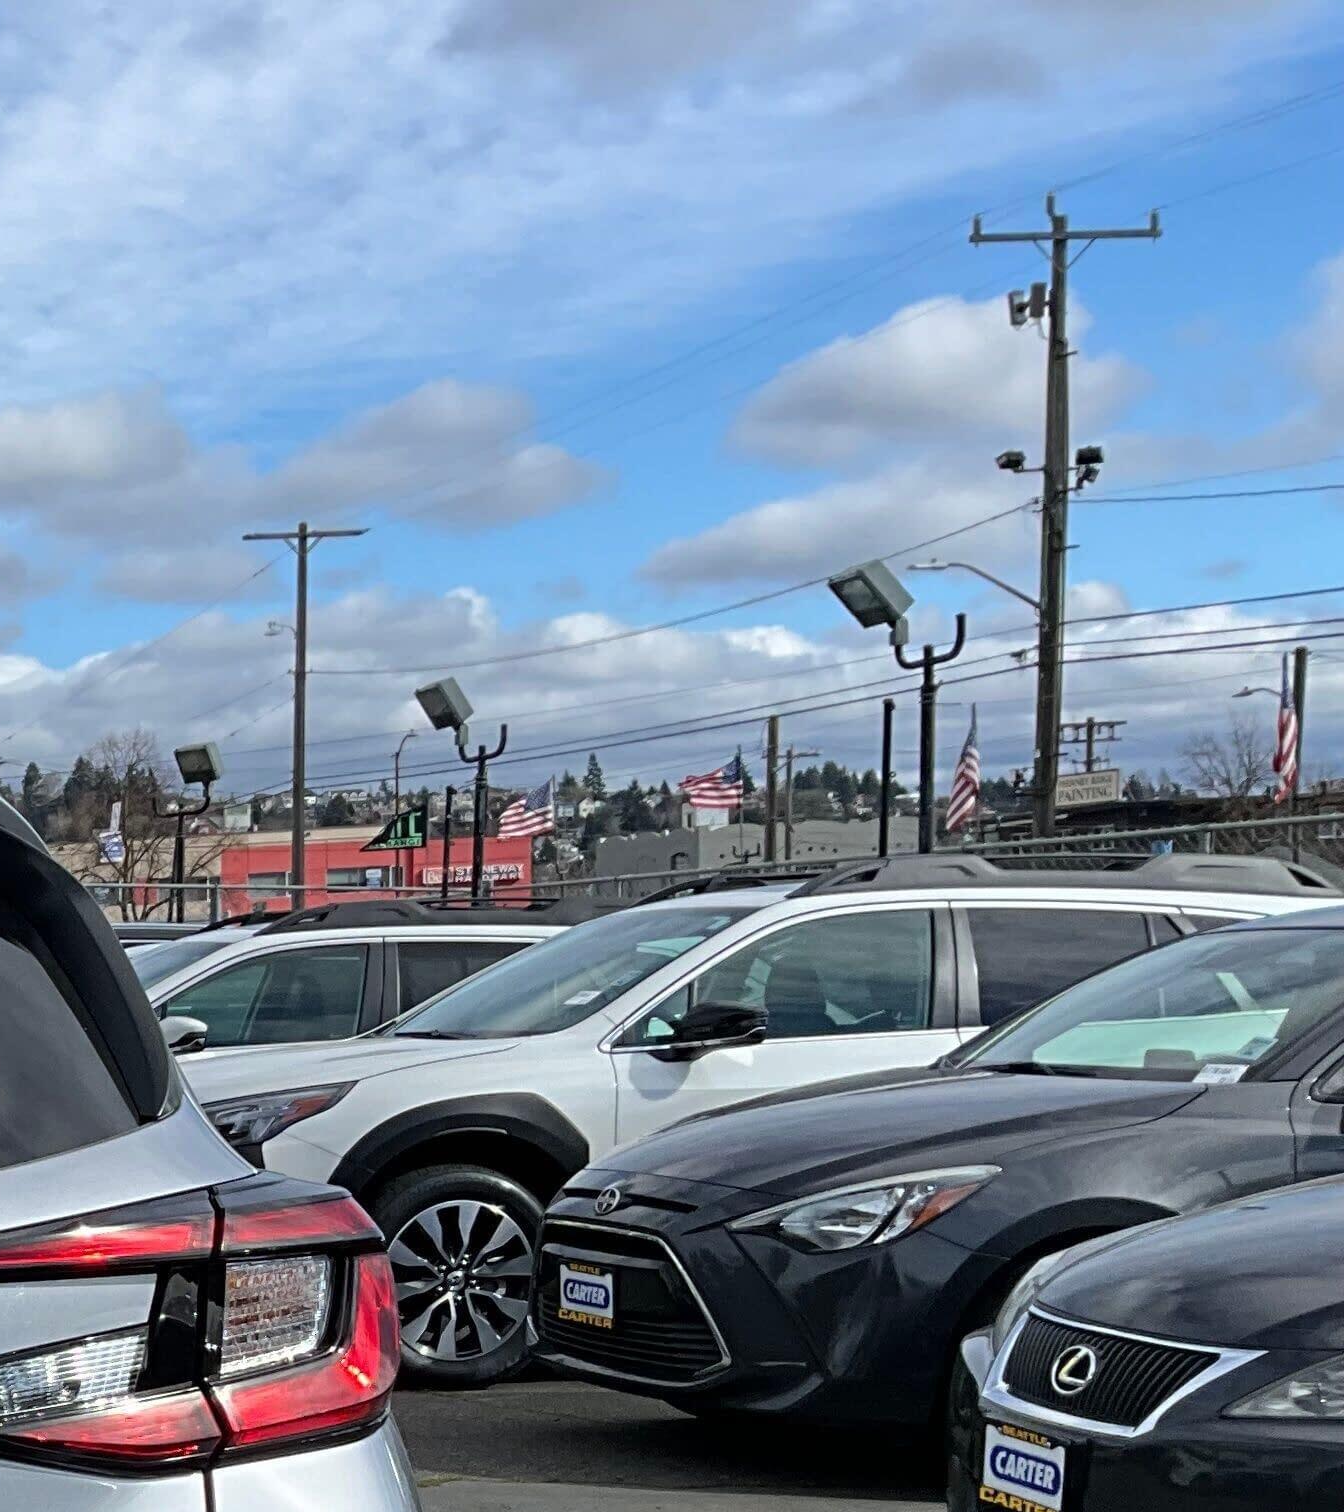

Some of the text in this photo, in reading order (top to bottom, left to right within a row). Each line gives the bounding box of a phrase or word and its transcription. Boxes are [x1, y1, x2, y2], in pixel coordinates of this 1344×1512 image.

[1058, 785, 1113, 802] PAINTING
[455, 864, 524, 876] STNEWAY
[455, 873, 524, 883] HADWARE
[566, 1282, 606, 1306] CARTER
[558, 1309, 613, 1329] CARTER
[1002, 1425, 1049, 1446] SEATTLE
[995, 1451, 1056, 1490] CARTER
